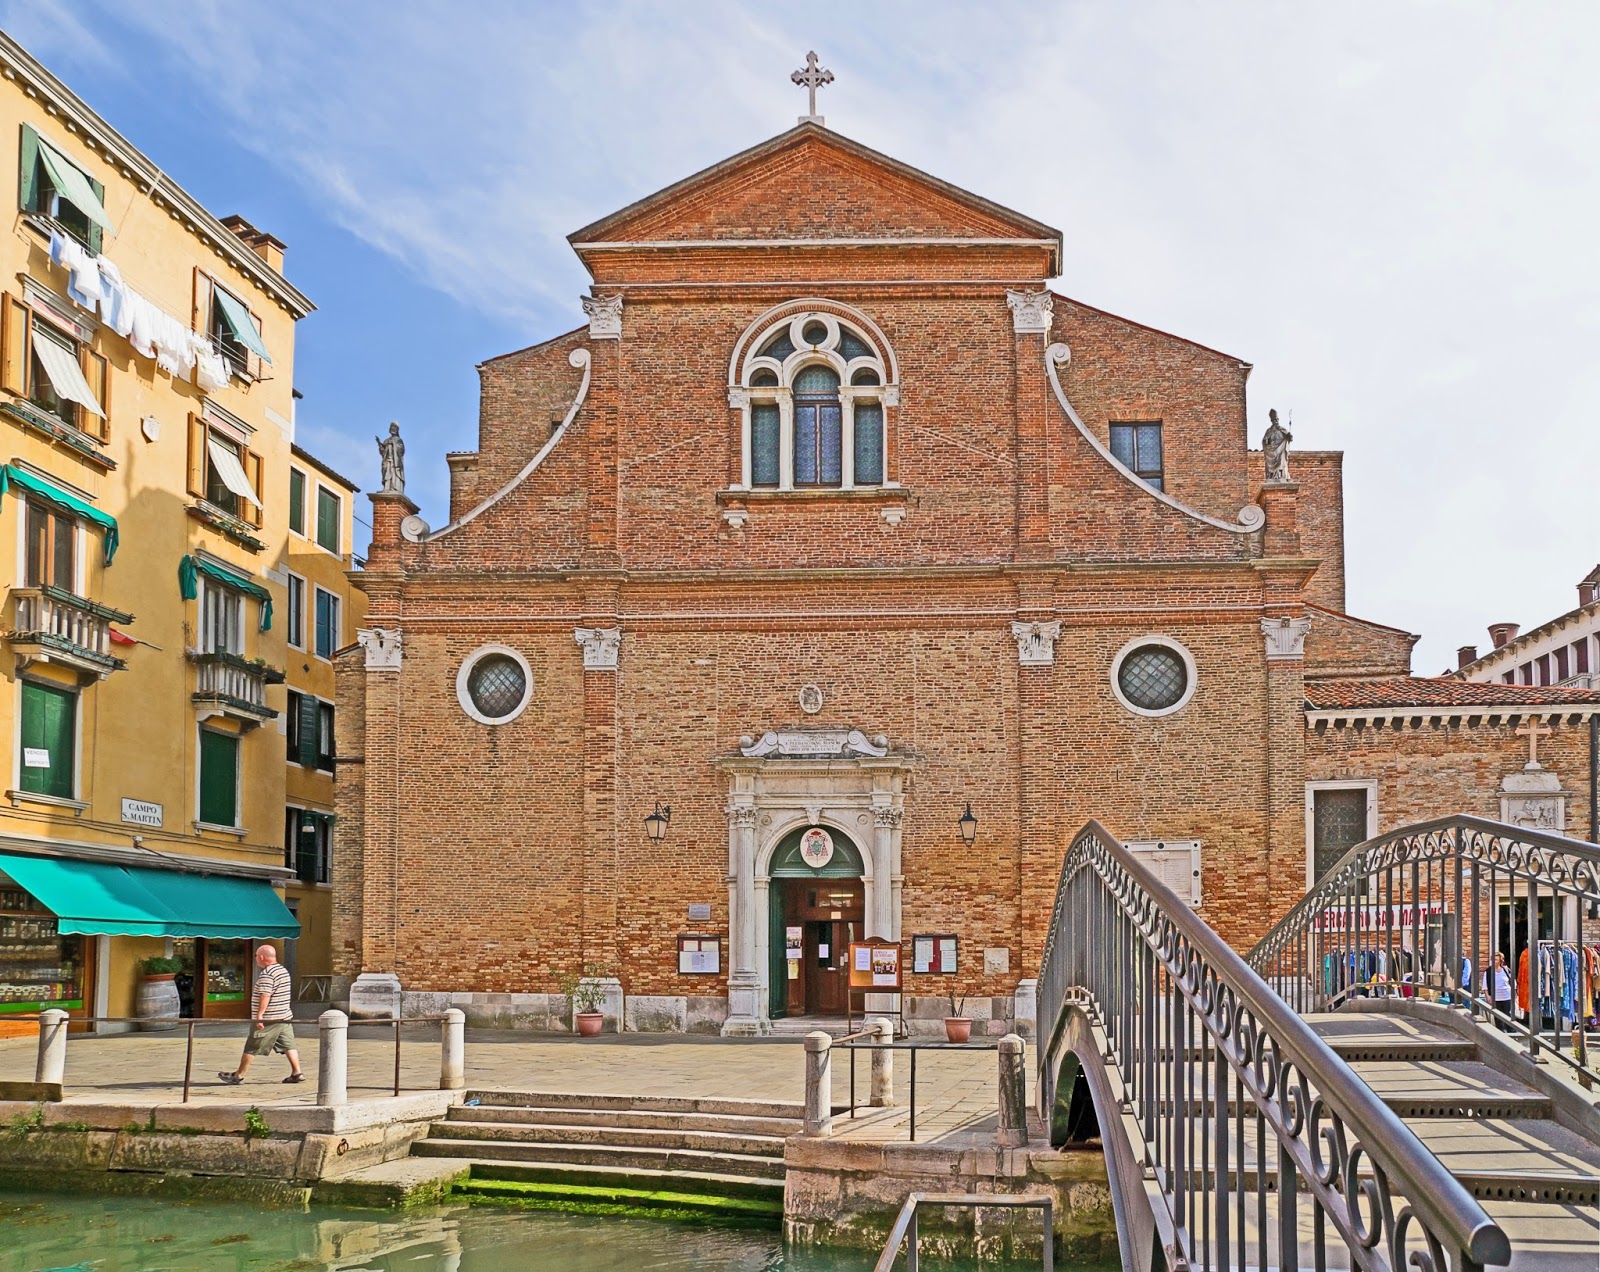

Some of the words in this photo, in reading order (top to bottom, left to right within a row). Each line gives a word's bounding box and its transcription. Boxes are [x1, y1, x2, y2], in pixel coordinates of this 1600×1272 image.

[128, 803, 157, 814] CAMPO
[1313, 911, 1371, 928] MERCATNO
[1399, 902, 1443, 926] MART
